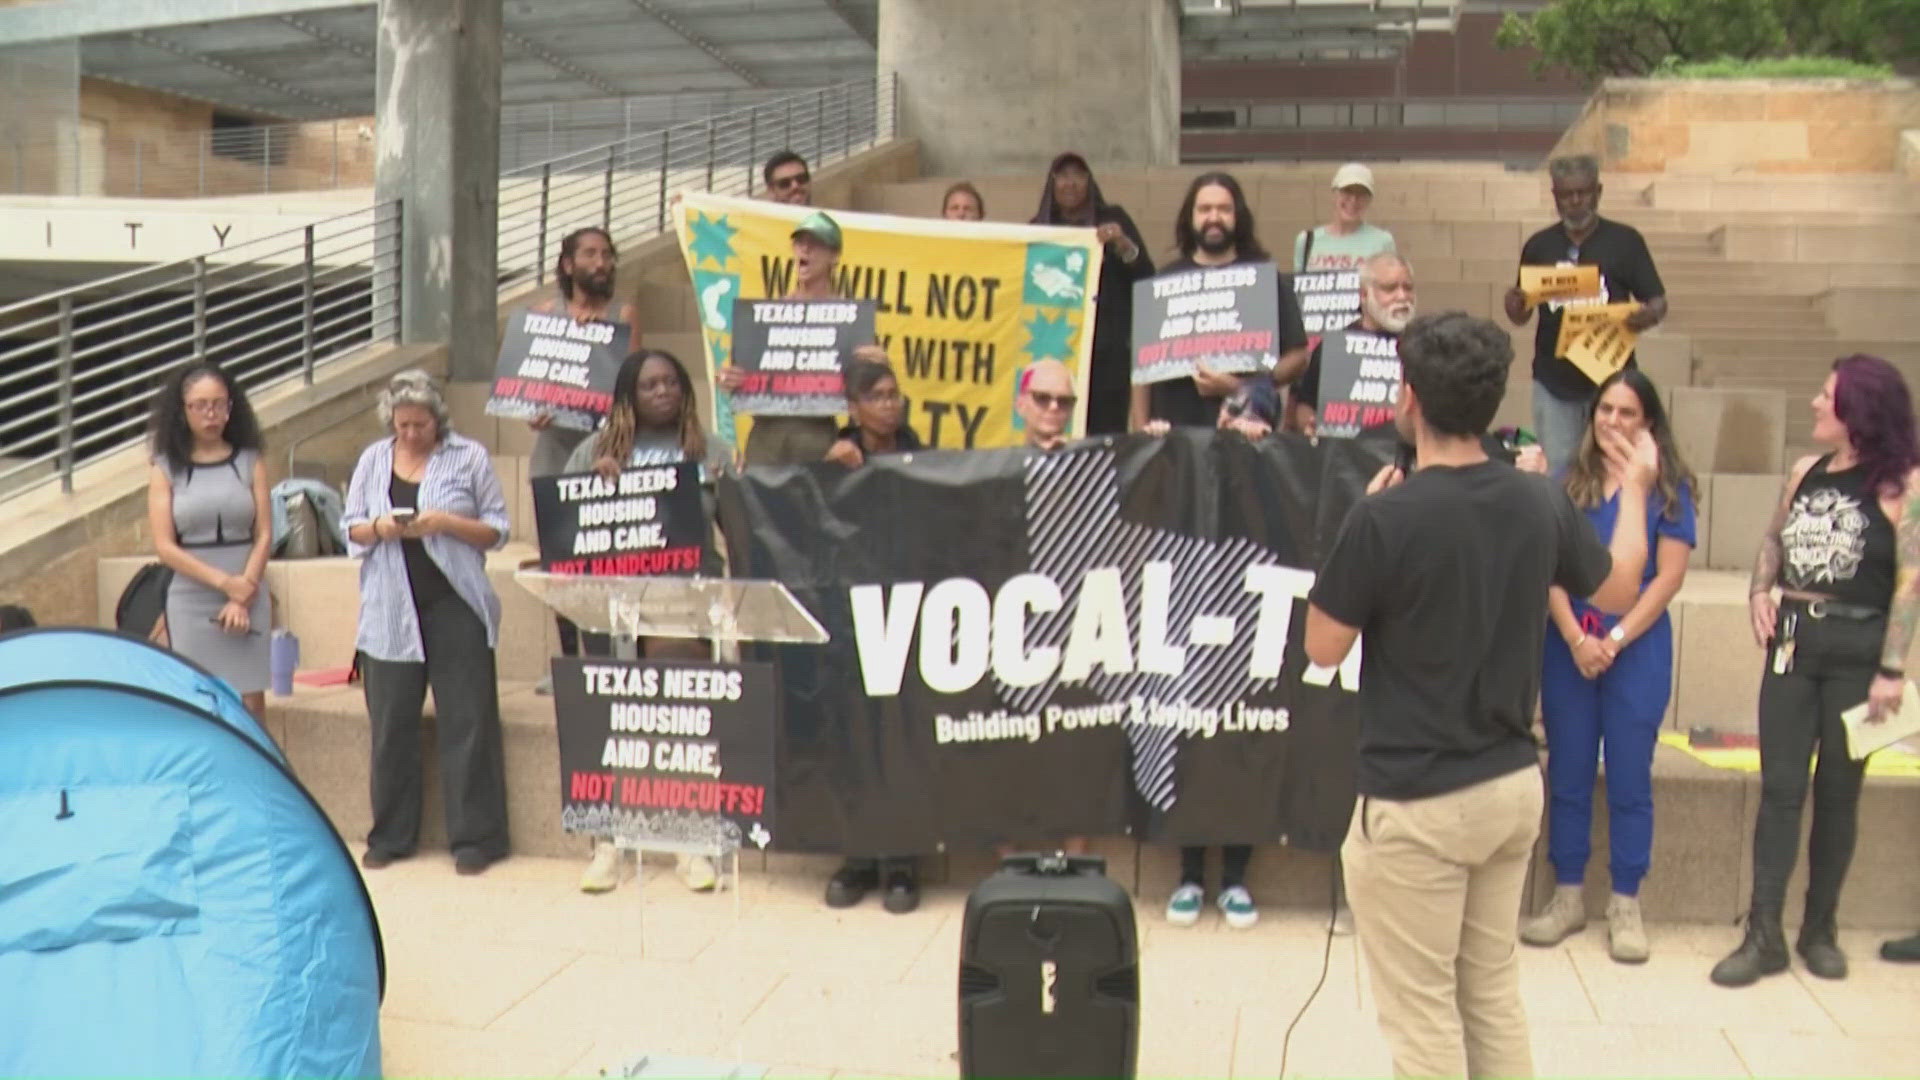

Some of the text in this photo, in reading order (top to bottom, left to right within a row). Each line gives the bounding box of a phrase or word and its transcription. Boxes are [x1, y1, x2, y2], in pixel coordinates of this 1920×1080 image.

[1153, 273, 1202, 300] TEXAS
[1293, 273, 1335, 293] TEXAS
[926, 273, 1001, 322] NOT
[523, 313, 567, 338] TEXAS
[753, 303, 804, 323] TEXAS
[1303, 314, 1325, 332] ND
[1159, 316, 1193, 340] AND
[759, 350, 795, 371] AND
[904, 335, 995, 385] WITH
[1137, 342, 1169, 366] NOT
[517, 357, 549, 379] AND
[494, 376, 522, 398] NOT
[1350, 380, 1387, 402] AND
[1323, 402, 1360, 425] NOT
[556, 467, 678, 502] TEXAS NEEDS
[578, 497, 657, 527] HOUSING
[573, 523, 668, 555] AND CARE,
[591, 547, 701, 577] HANDCUFFS!
[582, 665, 743, 701] TEXAS NEEDS
[609, 702, 712, 736] HOUSING
[935, 708, 1041, 744] Building
[1045, 701, 1125, 733] Power
[1223, 700, 1290, 732] Lives
[601, 738, 723, 778] AND CARE,
[571, 771, 766, 816] NOT HANDCUFFS!
